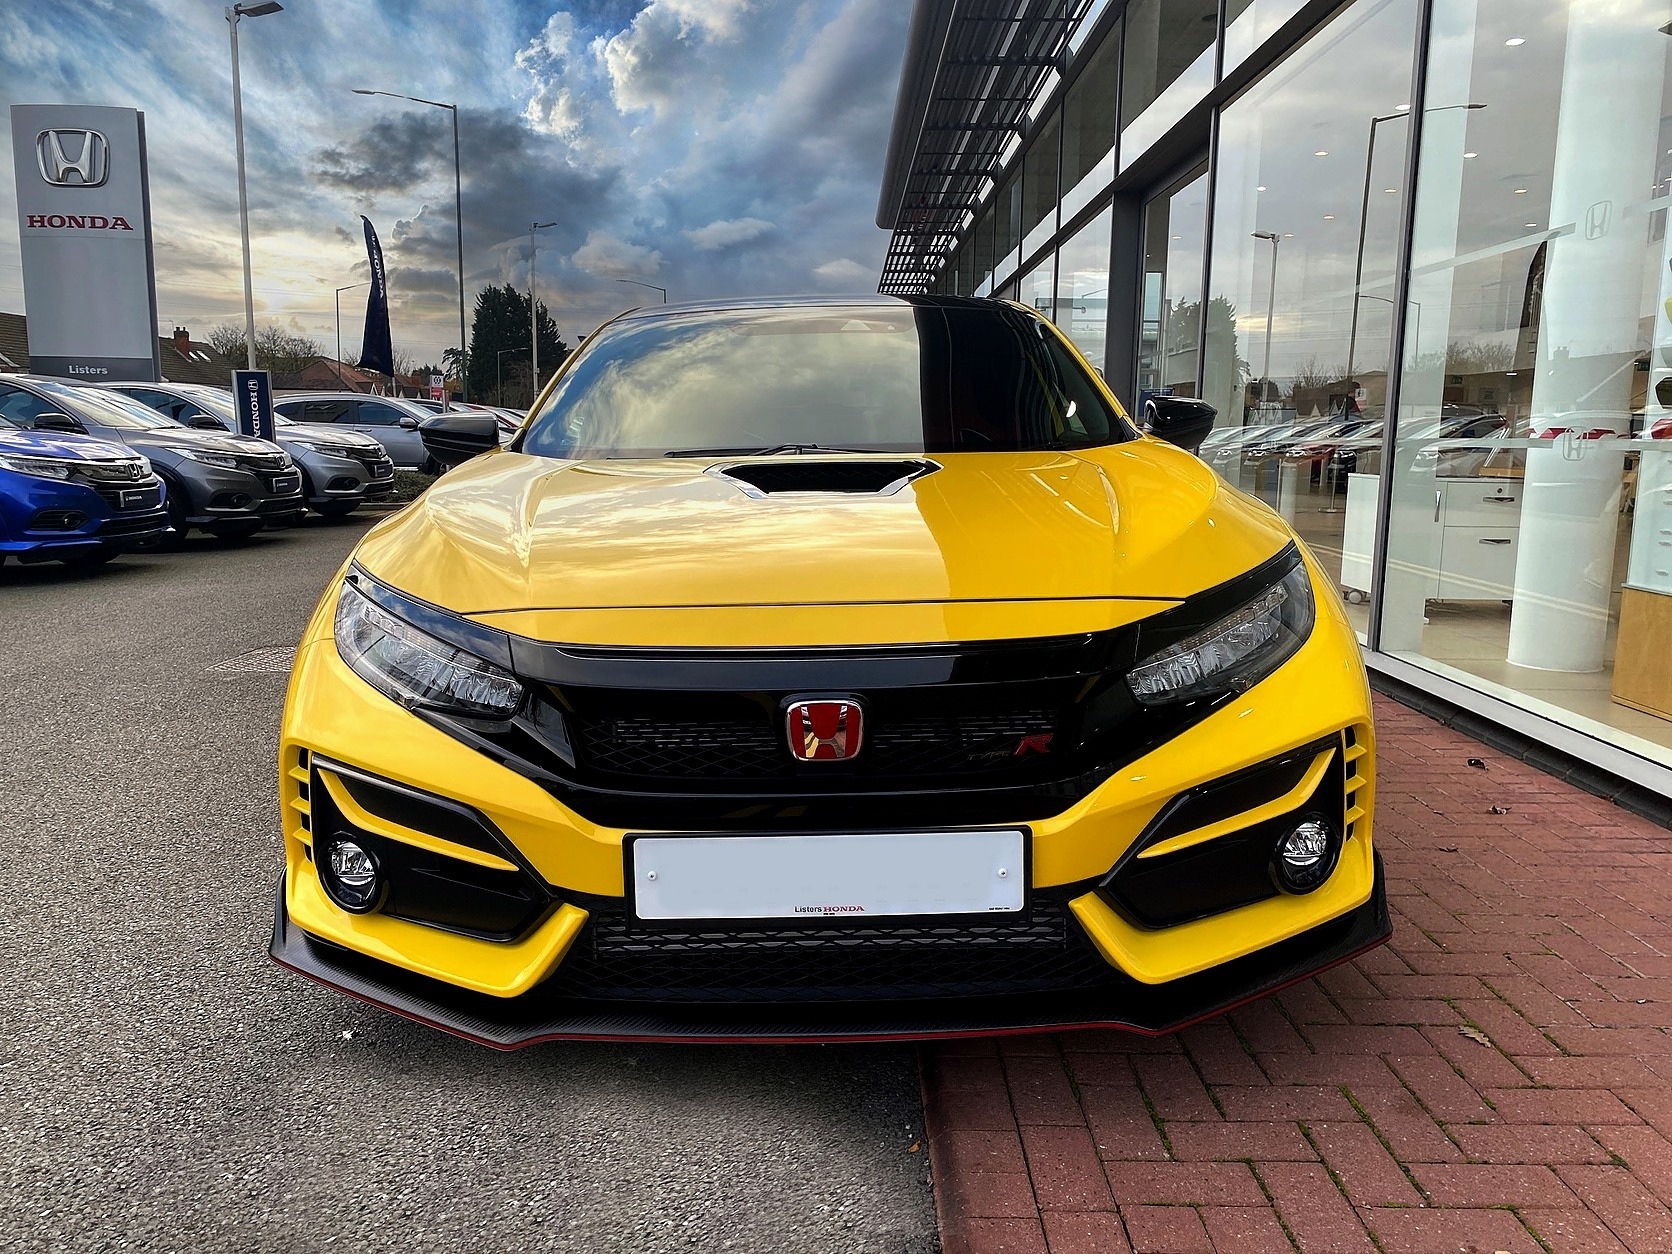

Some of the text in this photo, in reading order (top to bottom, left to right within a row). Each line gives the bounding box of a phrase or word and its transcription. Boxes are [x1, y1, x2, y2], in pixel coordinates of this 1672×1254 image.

[26, 214, 134, 231] HONDA
[68, 365, 108, 375] Listers
[250, 391, 261, 438] HONDA
[1013, 732, 1054, 757] R
[794, 905, 865, 913] Listers HONDA
